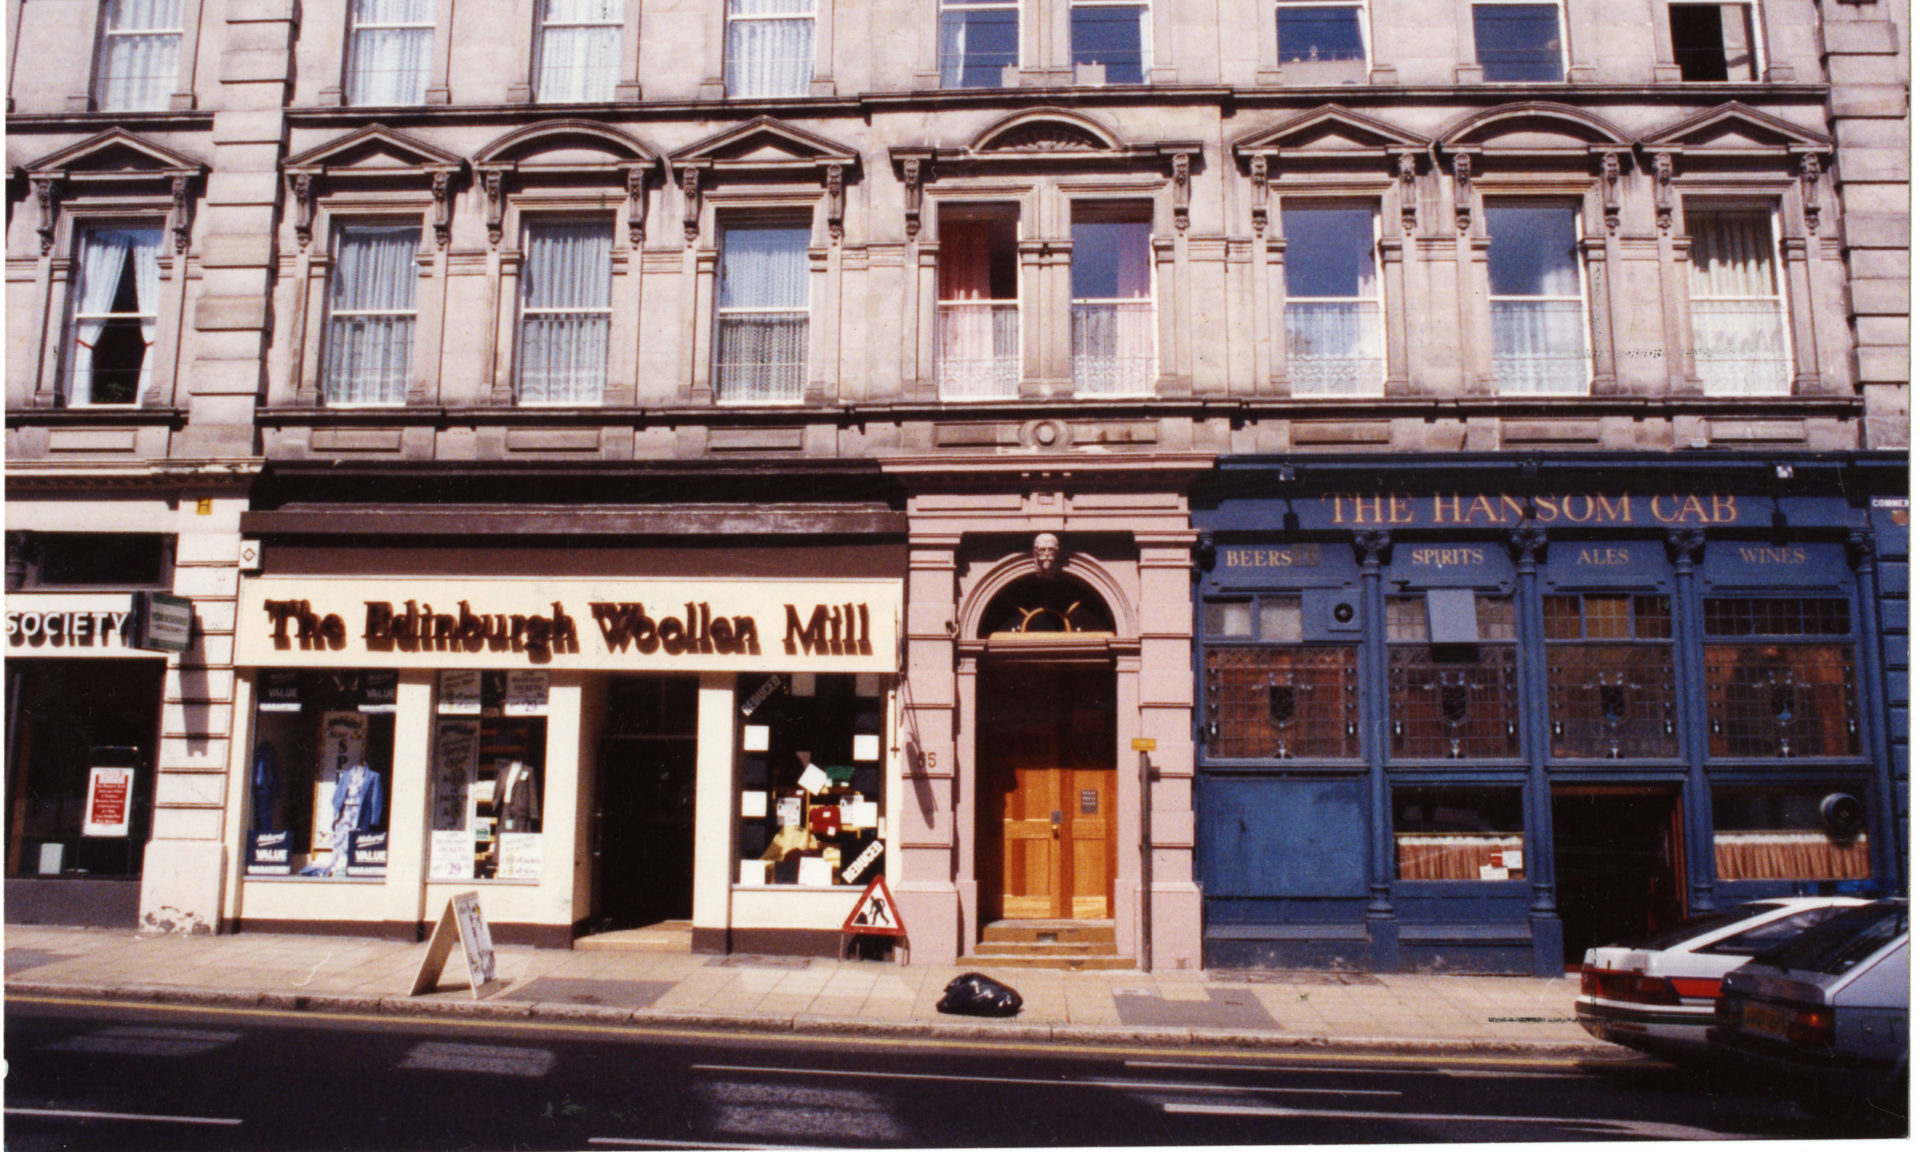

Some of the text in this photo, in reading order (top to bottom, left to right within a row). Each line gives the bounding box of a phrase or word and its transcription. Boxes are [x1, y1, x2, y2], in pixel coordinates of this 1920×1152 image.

[1321, 490, 1739, 524] THE HANSOM CAB
[1226, 549, 1293, 567] BEERS
[1411, 548, 1485, 565] SPIRITS
[1576, 548, 1630, 565] ALES
[1738, 547, 1806, 564] WINES
[5, 612, 129, 636] SOCIETY
[263, 598, 873, 664] The Edinburgh Woollen Mill
[267, 687, 299, 698] VALUE
[366, 688, 396, 698] VALUE
[740, 674, 782, 717] REDUCED
[255, 849, 288, 862] VALUE
[355, 850, 388, 863] VALUE
[841, 840, 884, 884] REDUCED
